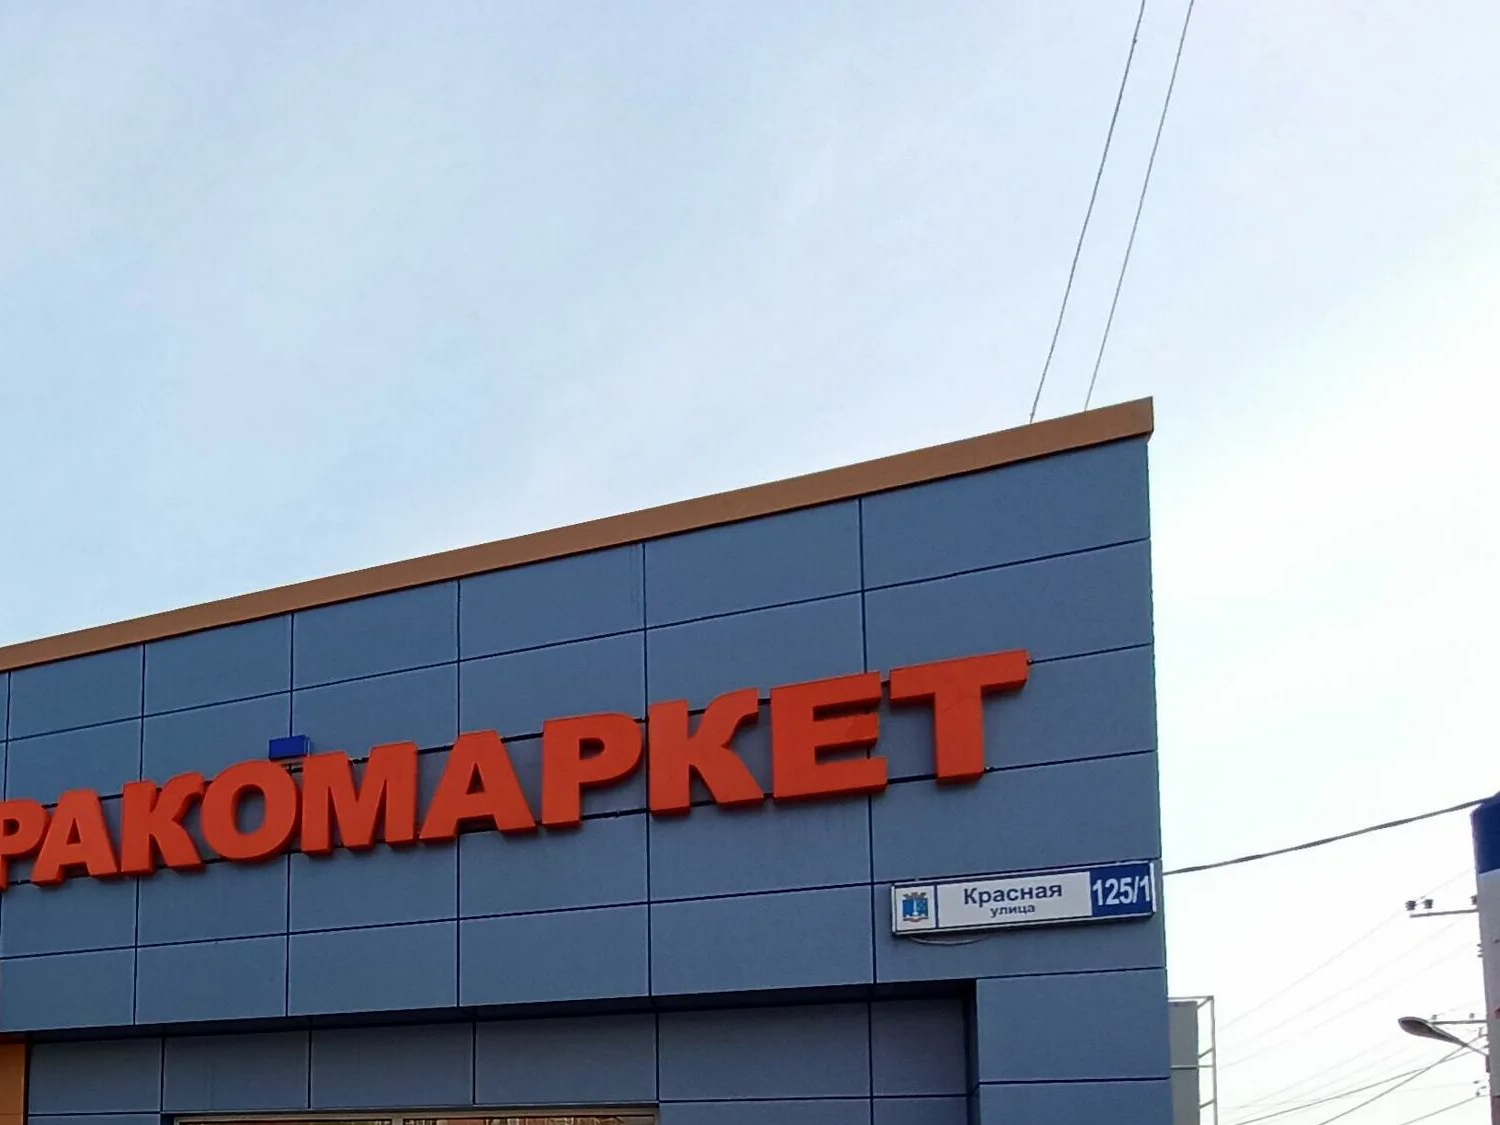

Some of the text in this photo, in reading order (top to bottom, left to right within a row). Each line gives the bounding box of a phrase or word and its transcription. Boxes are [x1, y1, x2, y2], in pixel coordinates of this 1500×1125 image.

[963, 875, 1151, 907] Красная 125/1
[990, 902, 1035, 918] улица
